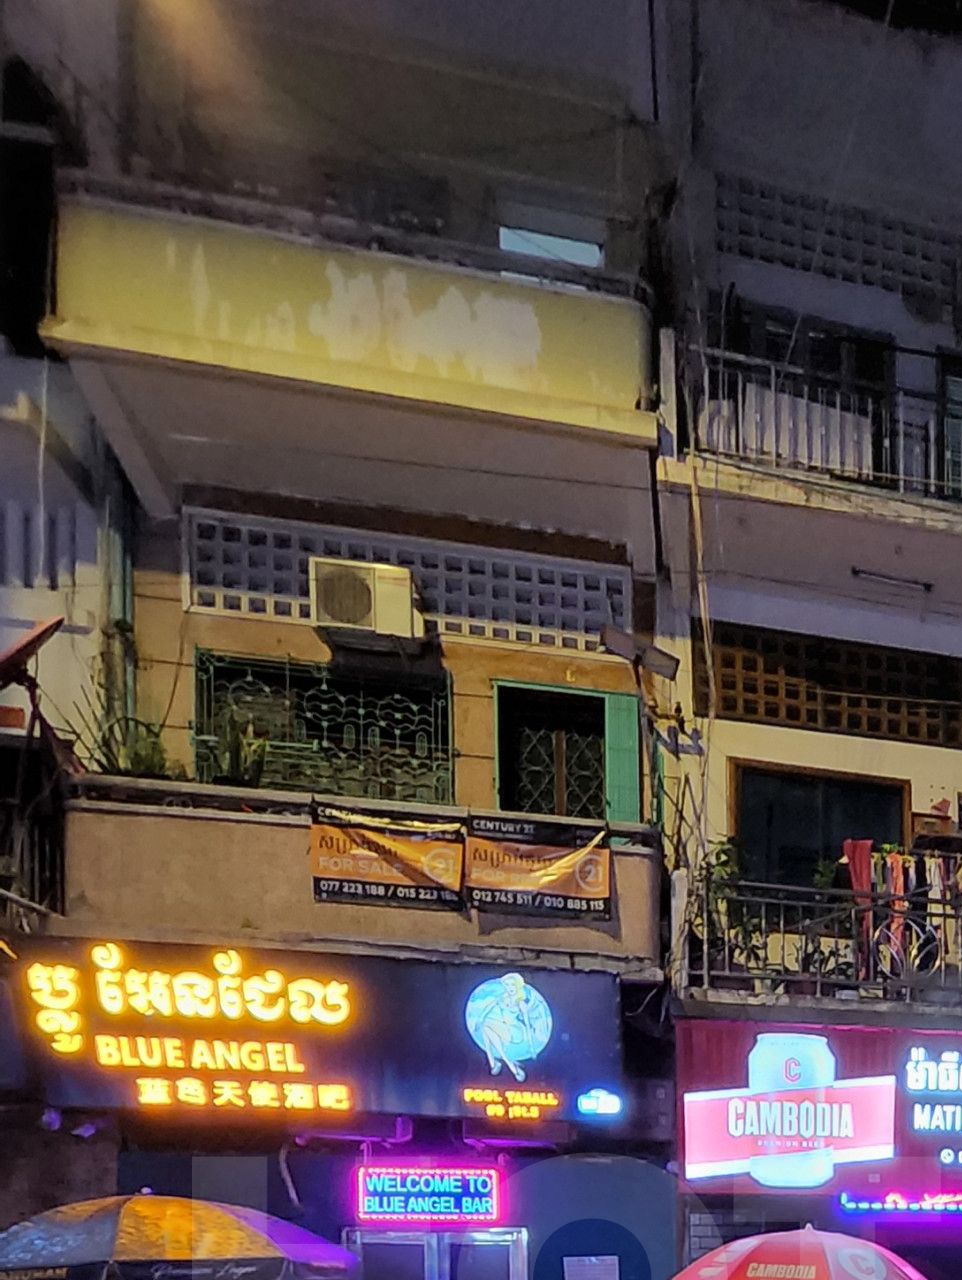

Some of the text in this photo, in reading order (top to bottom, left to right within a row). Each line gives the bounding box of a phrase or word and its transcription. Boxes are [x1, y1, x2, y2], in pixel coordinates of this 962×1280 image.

[472, 819, 521, 834] CENTURY
[319, 857, 352, 874] FOR
[320, 880, 339, 892] 077
[472, 889, 492, 900] 012
[544, 897, 564, 908] 010
[95, 1034, 305, 1073] BLUE ANGEL
[727, 1098, 855, 1140] CAMBODIA
[366, 1174, 493, 1193] WELCOME TO
[364, 1195, 493, 1213] BLUE ANGEL BAR
[746, 1262, 817, 1280] CAMBODIA
